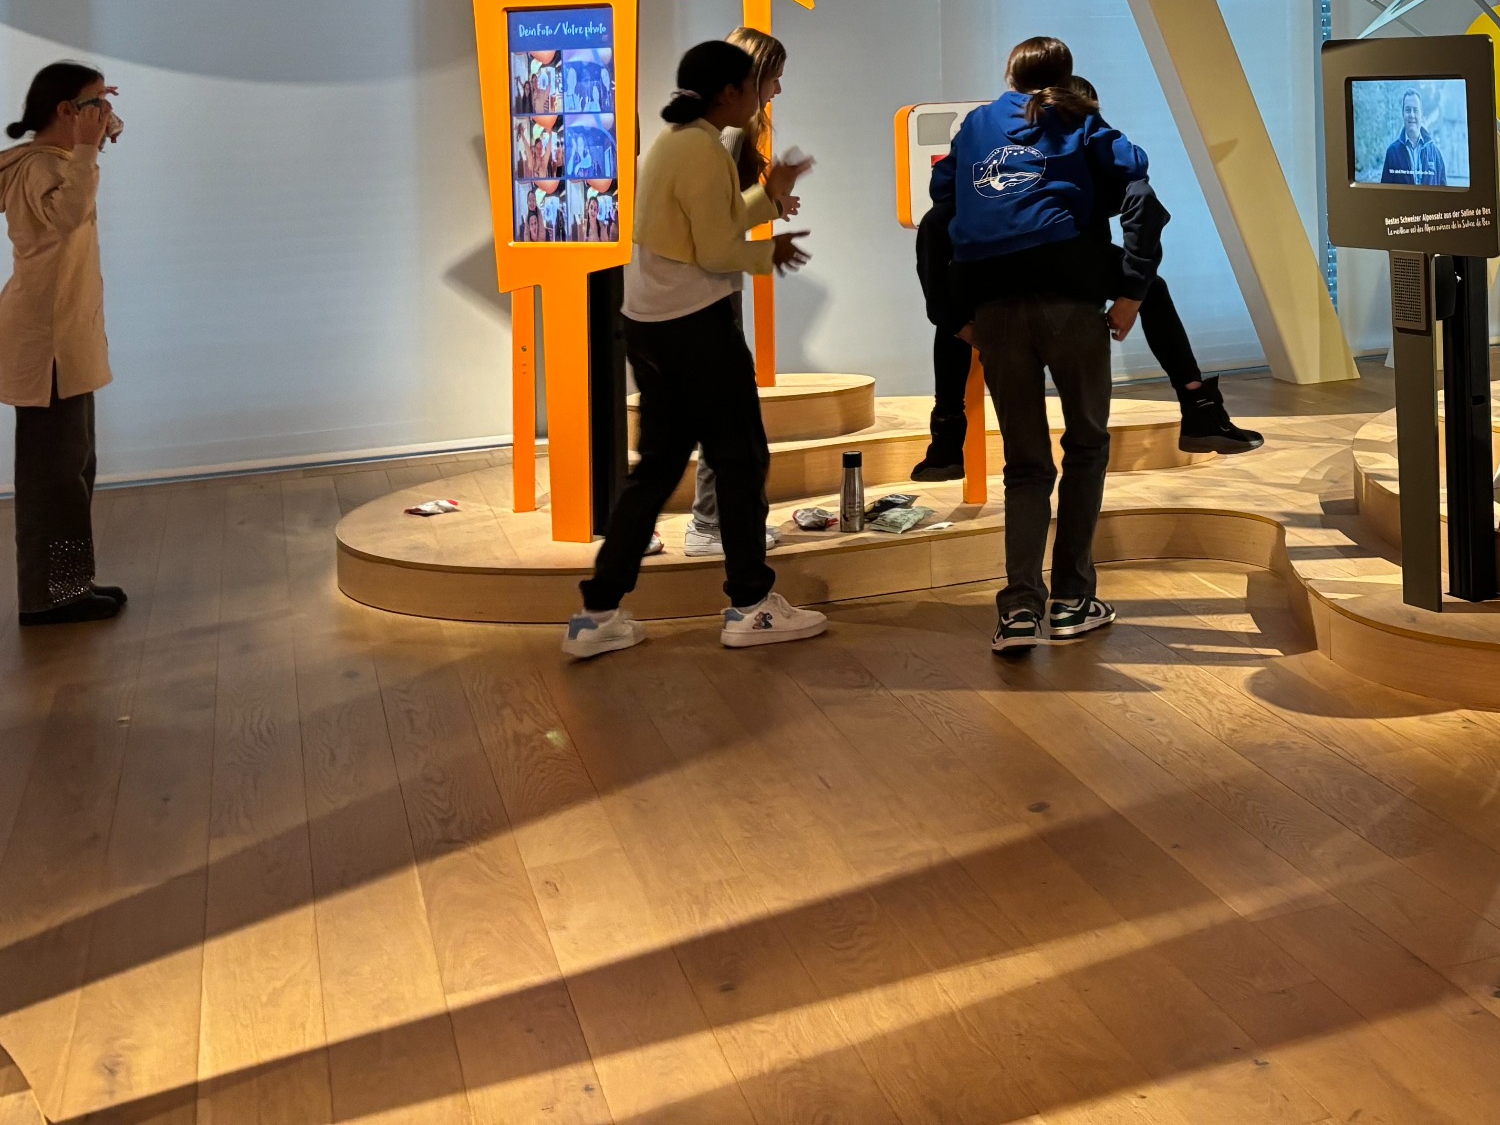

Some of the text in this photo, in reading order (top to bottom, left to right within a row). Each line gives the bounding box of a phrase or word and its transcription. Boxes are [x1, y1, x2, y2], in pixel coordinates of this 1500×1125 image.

[519, 25, 536, 37] Dein
[537, 24, 552, 36] Foto
[563, 21, 583, 35] Votre
[585, 21, 606, 37] photo
[1400, 215, 1421, 223] Schweizer
[1422, 212, 1442, 222] Alpensalz
[1461, 209, 1474, 217] Saline
